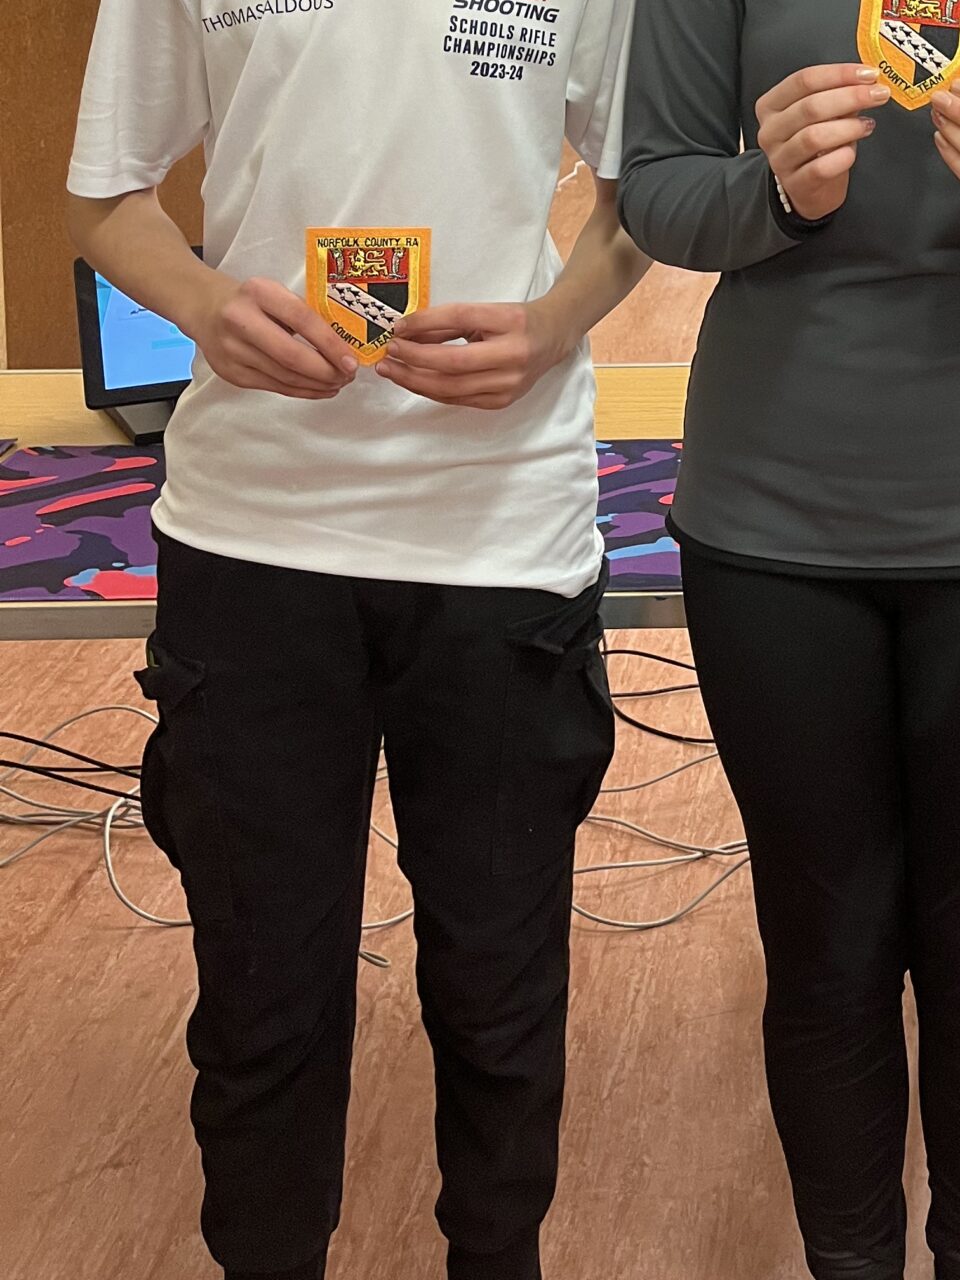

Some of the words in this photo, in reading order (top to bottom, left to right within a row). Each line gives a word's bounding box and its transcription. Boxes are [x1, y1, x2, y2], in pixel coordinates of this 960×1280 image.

[449, 15, 515, 40] SCHOOLS
[519, 27, 557, 47] RIFLE
[443, 35, 556, 67] CHAMPIONSHIPS
[470, 60, 524, 81] 2023-24
[878, 60, 911, 92] COUNTY
[917, 73, 945, 94] TEAM
[317, 237, 360, 248] NORFOLK
[364, 237, 401, 248] COUNTY
[405, 237, 419, 247] RA
[330, 322, 365, 349] COUNTY
[371, 327, 395, 350] TEAM
